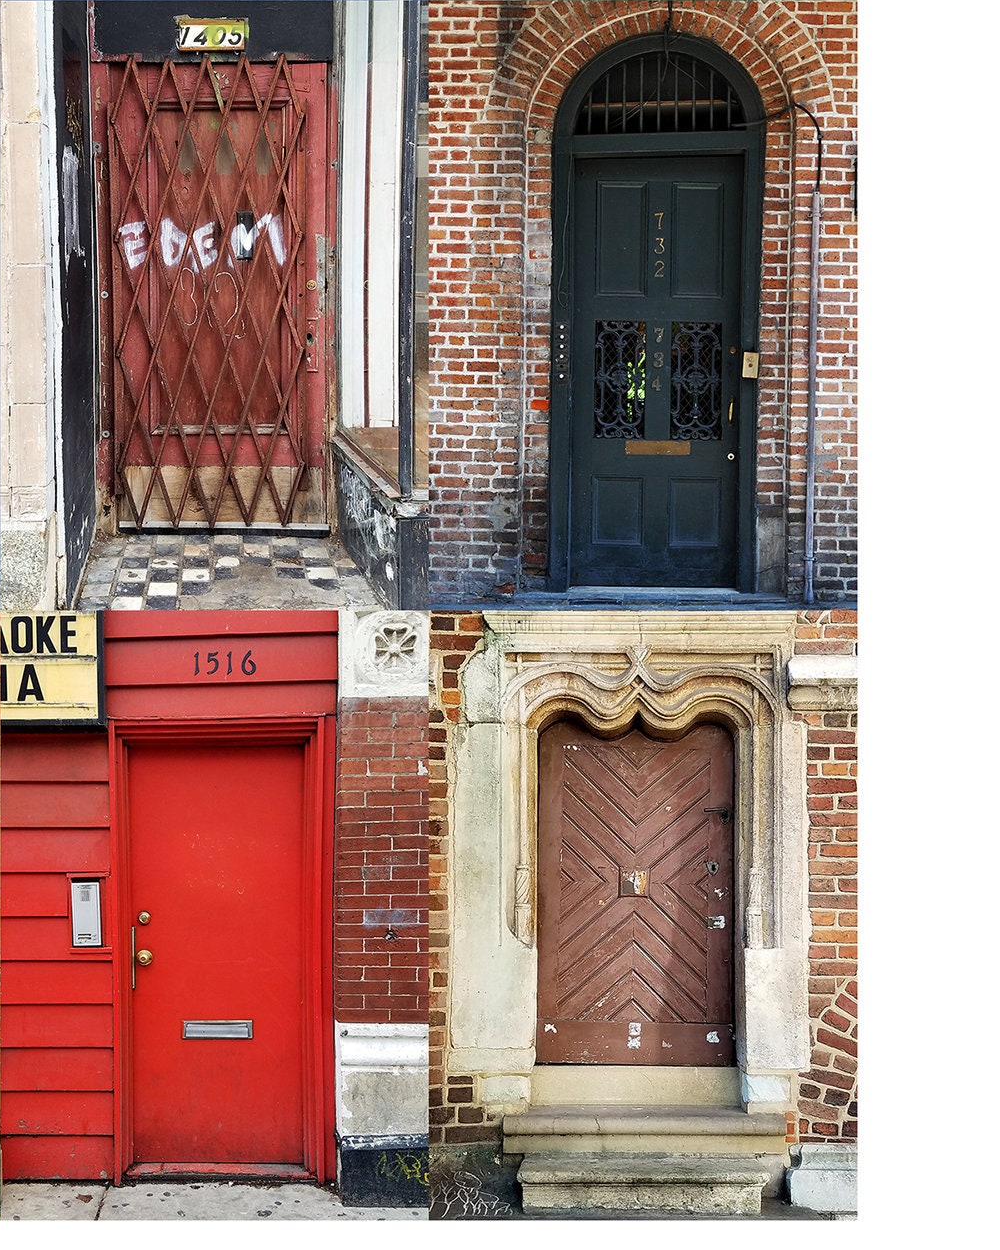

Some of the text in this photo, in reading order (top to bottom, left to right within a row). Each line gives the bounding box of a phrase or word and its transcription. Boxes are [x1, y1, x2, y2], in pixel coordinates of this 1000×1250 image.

[181, 26, 242, 46] 1405
[653, 212, 666, 279] 732
[194, 650, 257, 676] 1516
